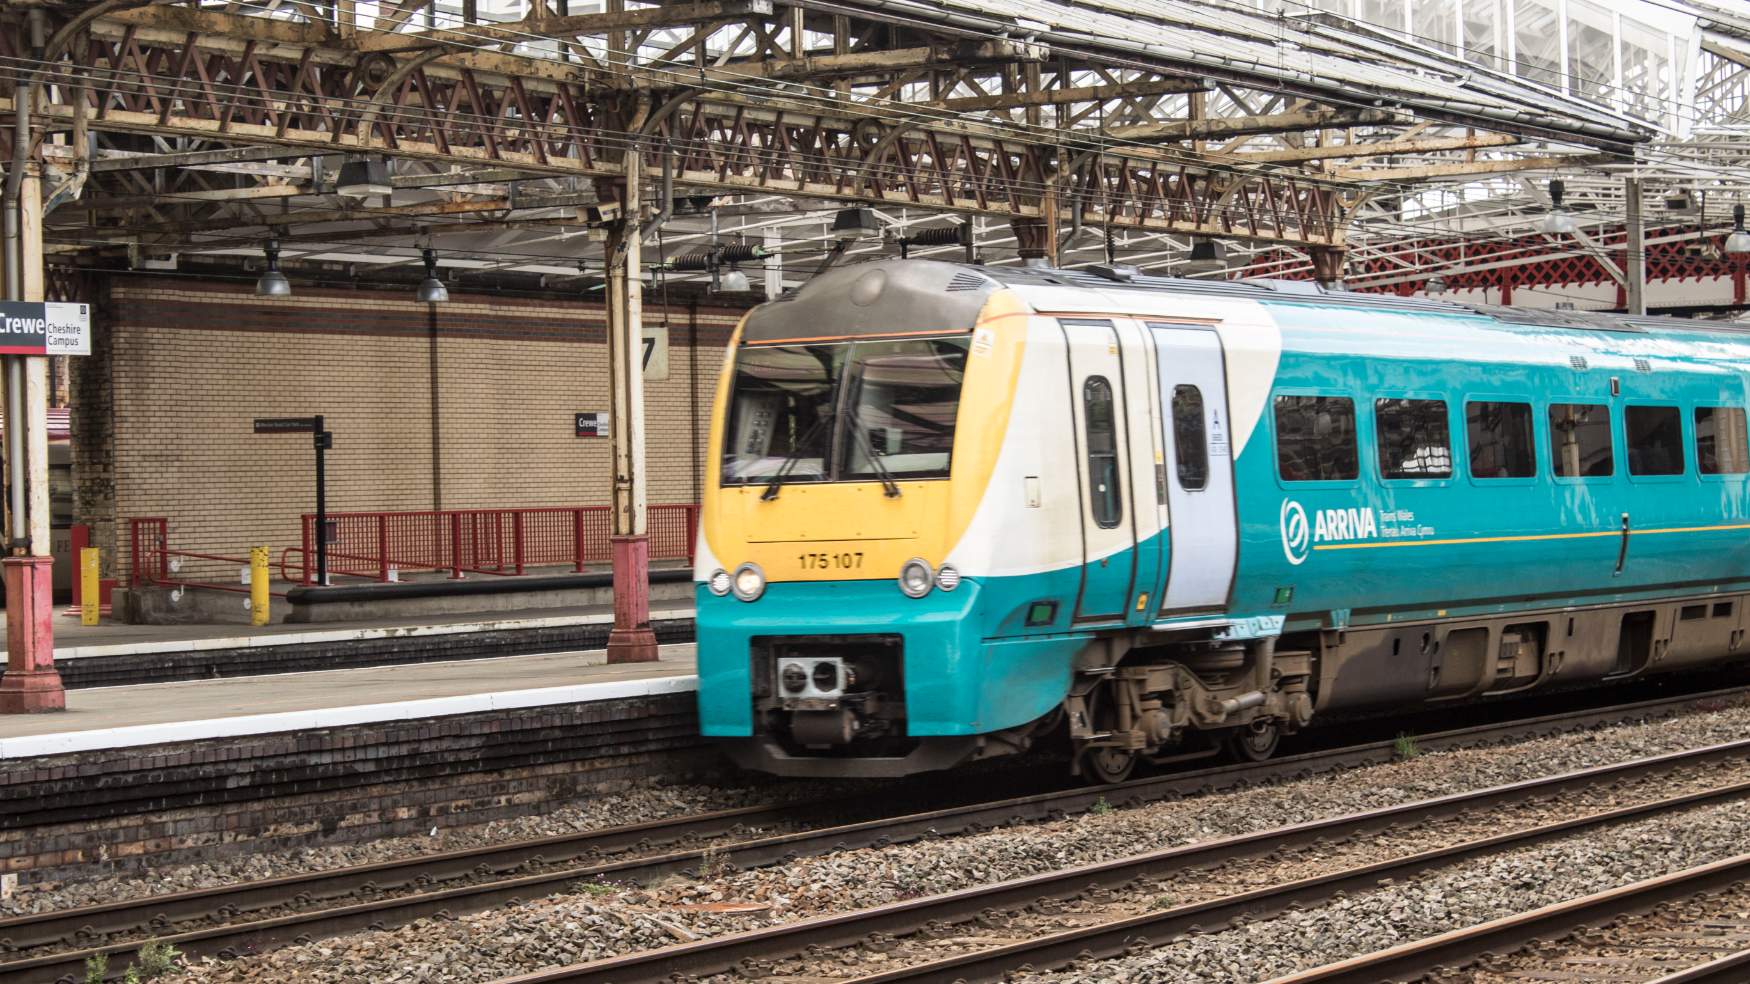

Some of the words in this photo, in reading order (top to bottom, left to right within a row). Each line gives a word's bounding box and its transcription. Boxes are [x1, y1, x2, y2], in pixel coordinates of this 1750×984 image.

[0, 313, 45, 335] Crewe
[47, 323, 81, 335] Cheshire
[48, 335, 79, 348] Campus
[641, 337, 656, 373] 7
[1313, 507, 1378, 542] ARRIVA
[797, 552, 829, 570] 175
[832, 551, 864, 569] 107
